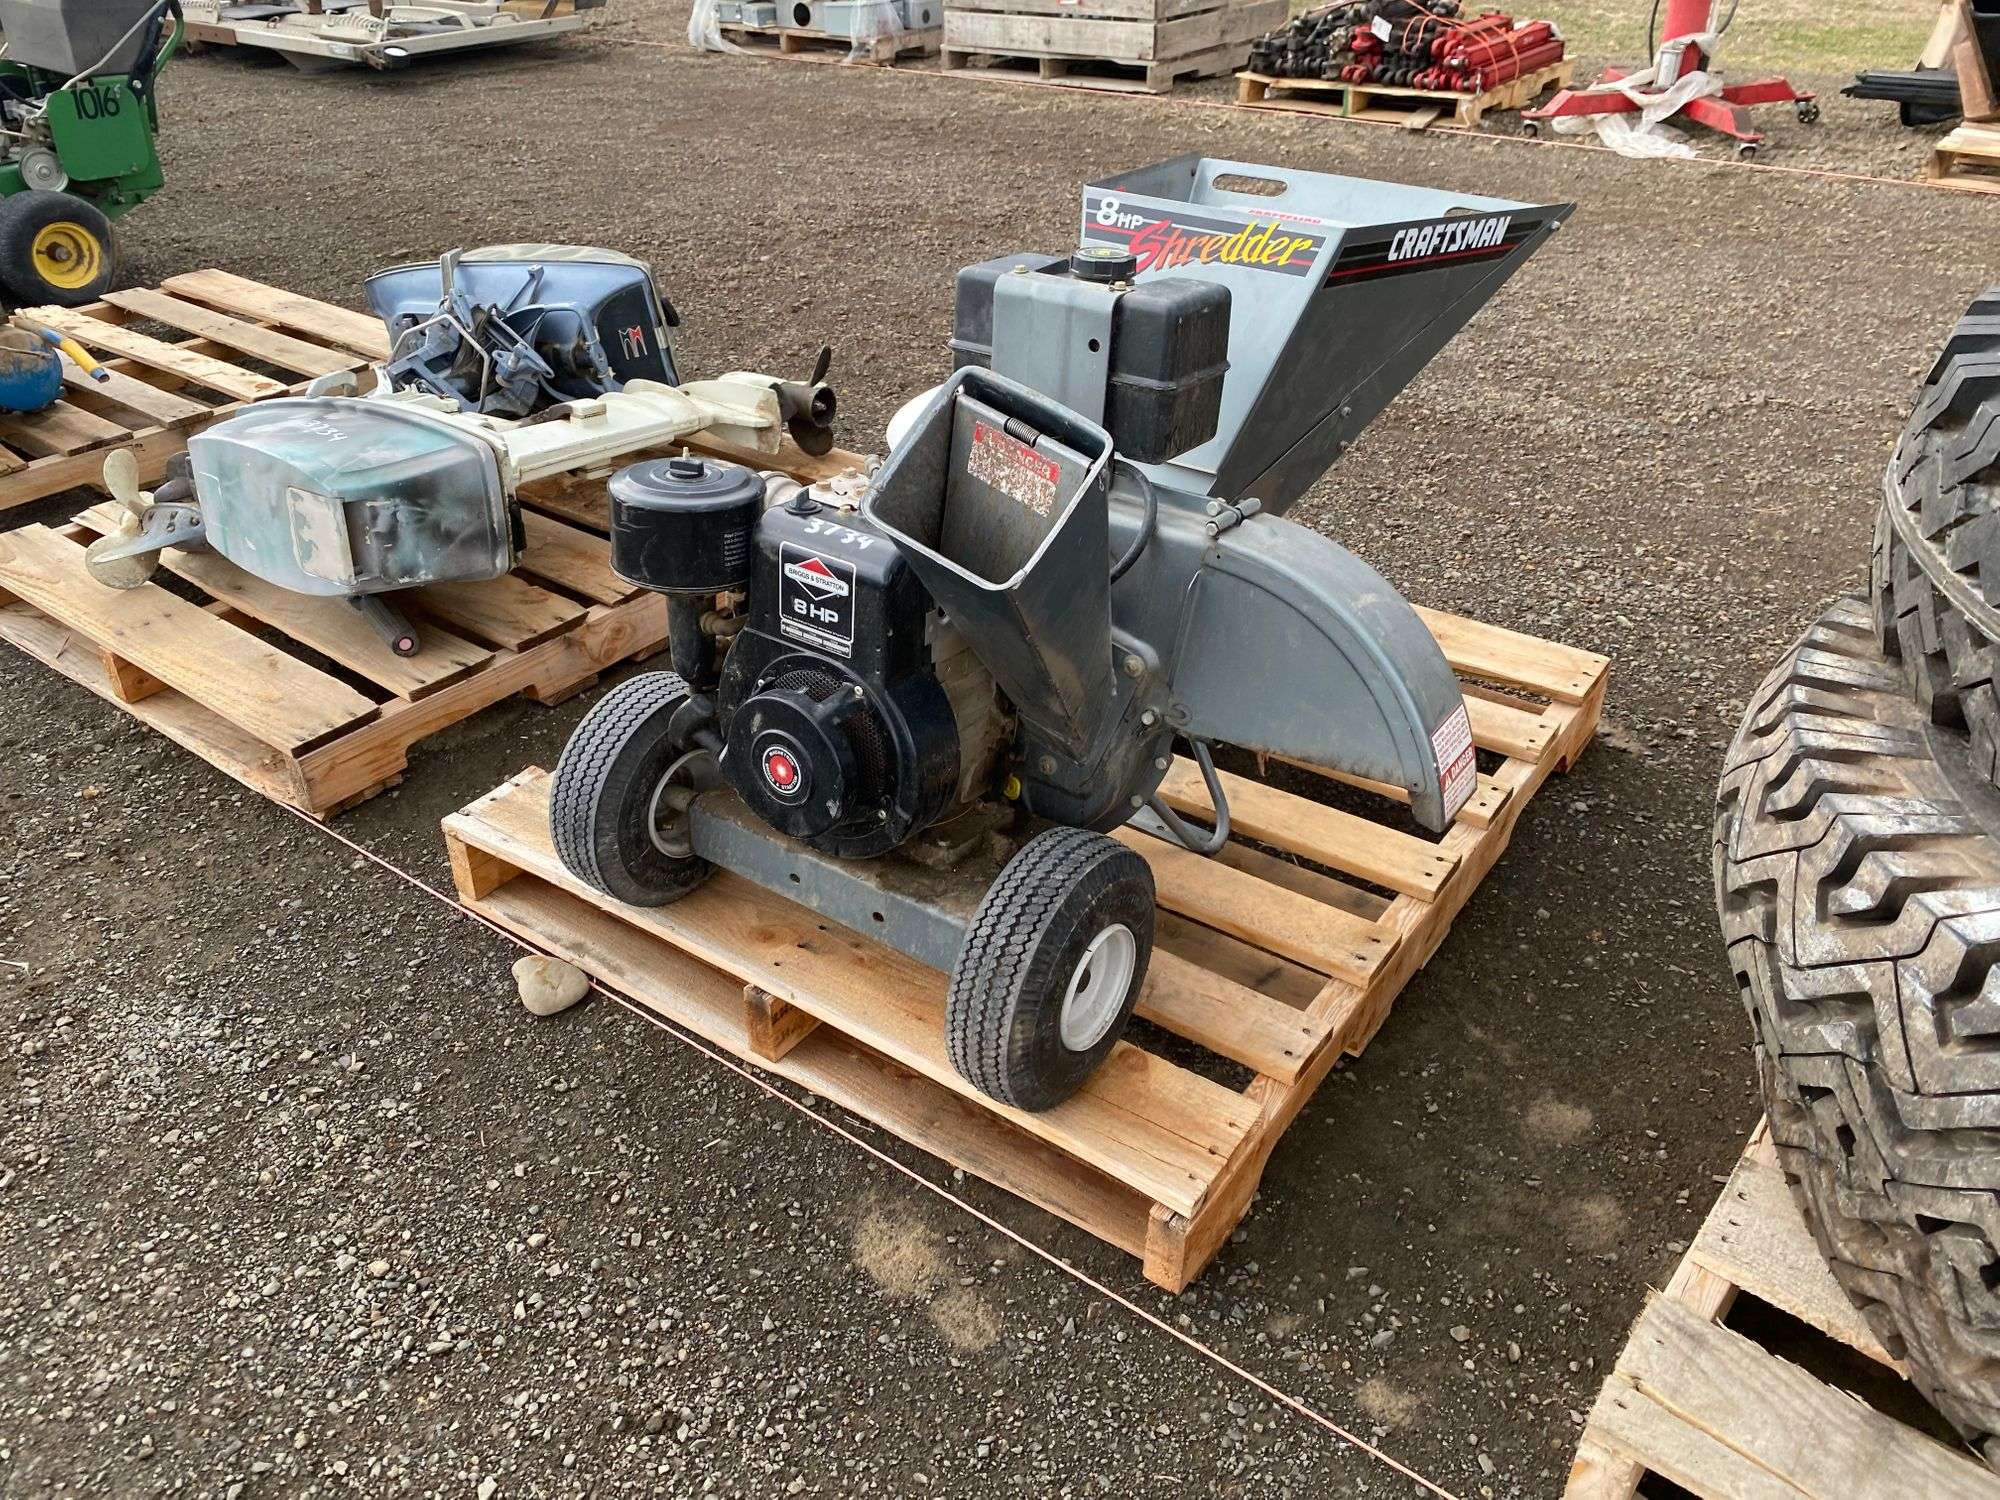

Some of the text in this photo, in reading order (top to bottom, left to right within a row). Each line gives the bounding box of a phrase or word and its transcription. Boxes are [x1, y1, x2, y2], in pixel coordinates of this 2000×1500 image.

[71, 86, 120, 119] 1016
[1128, 218, 1314, 274] Shredder
[1387, 216, 1512, 261] CRAFTSMAN
[788, 567, 810, 580] BRIGGS
[815, 577, 845, 592] STRATTON
[793, 598, 839, 623] 8 HP
